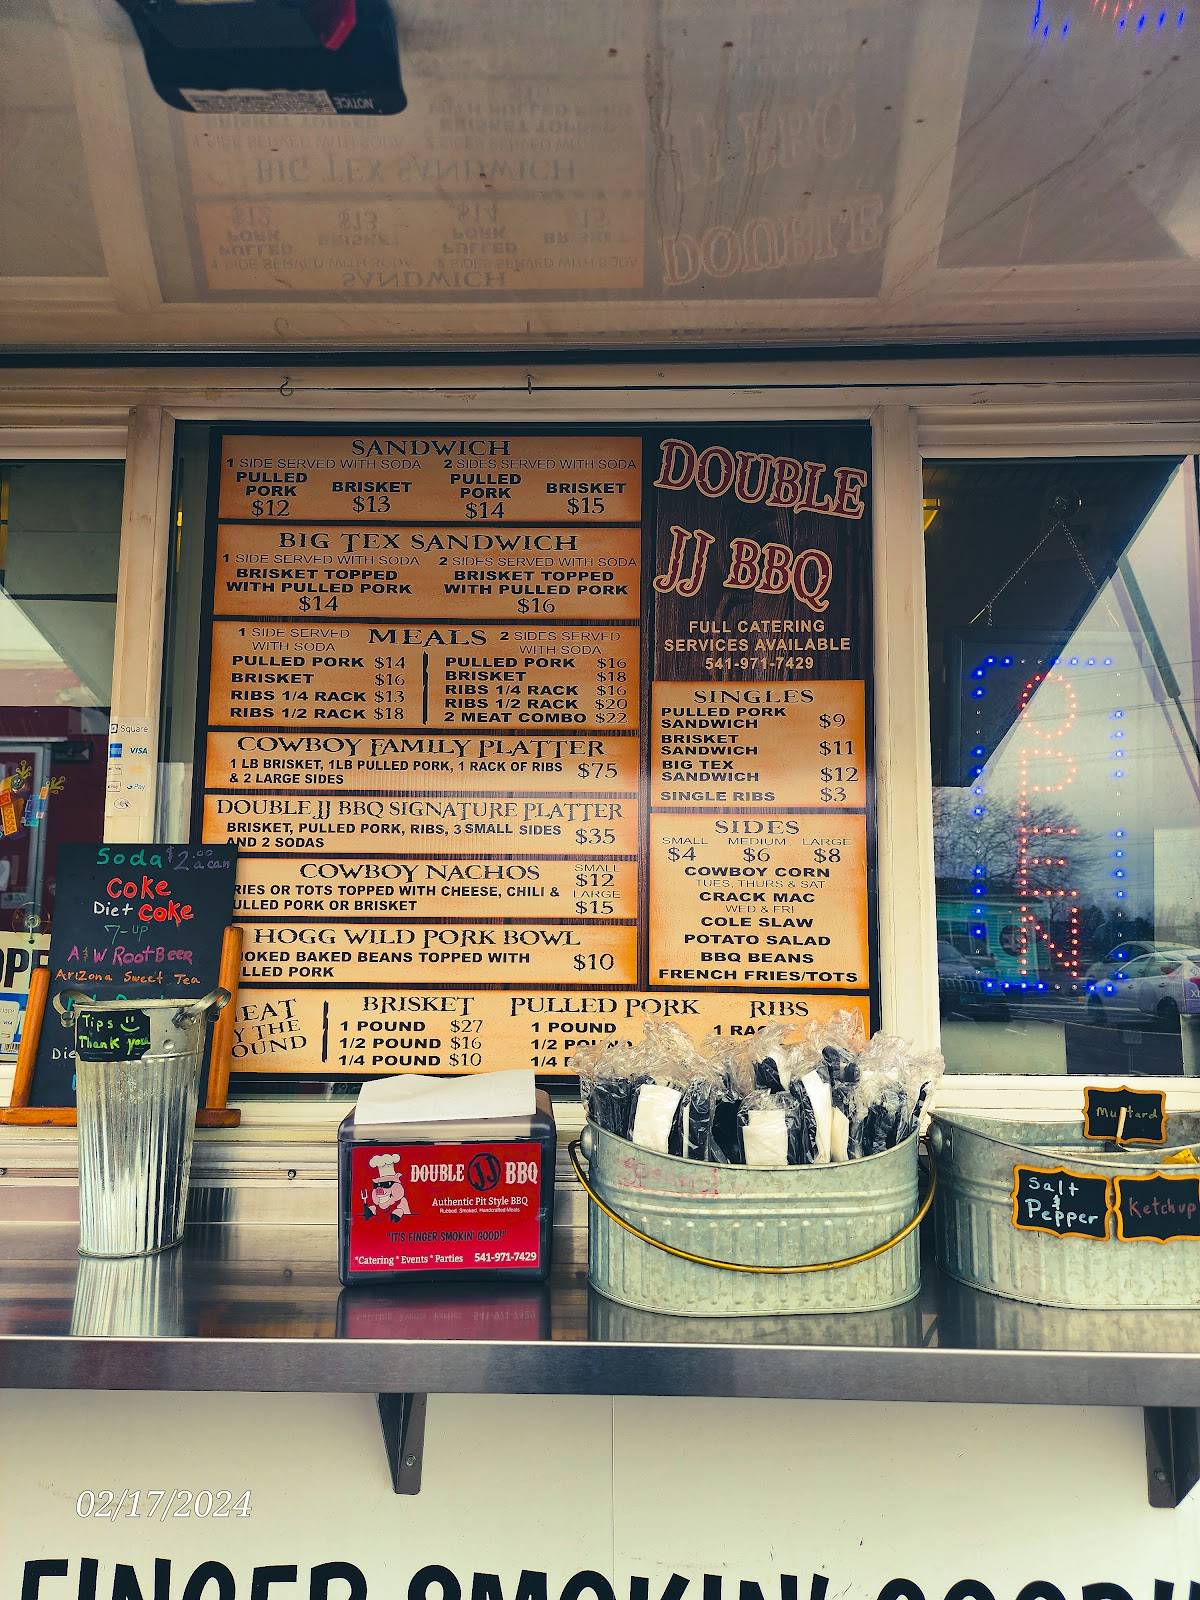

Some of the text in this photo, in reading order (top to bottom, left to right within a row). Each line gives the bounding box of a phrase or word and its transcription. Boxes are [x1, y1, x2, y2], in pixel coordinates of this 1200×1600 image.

[334, 96, 374, 110] NOTICE
[352, 439, 510, 458] SANDWICH
[226, 458, 422, 469] 1 SIDE SERVED WITH SODA
[236, 472, 307, 483] PULLED
[450, 473, 521, 485] PULLED
[653, 438, 867, 520] DOUBLE
[245, 486, 296, 497] PORK
[332, 482, 412, 493] BRISKET
[460, 488, 511, 499] PORK
[546, 483, 626, 494] BRISKET
[252, 499, 289, 518] $12
[353, 497, 391, 514] $13
[465, 501, 505, 519] $14
[567, 498, 605, 514] $15
[279, 532, 577, 553] BIG TEX SANDWICH
[236, 569, 398, 580] BRISKET TOPPED
[653, 525, 833, 613] JJ BBQ
[226, 582, 412, 594] WITH PULLED PORK
[298, 595, 338, 613] $14
[689, 619, 825, 633] FULL CATERING
[368, 628, 488, 648] MEALS
[664, 638, 850, 652] SERVICES AVAILABLE
[232, 655, 405, 671] PULLED PORK $14
[705, 656, 814, 670] 541-971-7429
[231, 672, 405, 686] BRISKET $16
[694, 689, 814, 704] SINGLES
[230, 706, 404, 721] RIBS 1/2 RACK $18
[444, 711, 627, 726] 2 MEAT COMBO $22
[120, 725, 148, 734] Square
[237, 736, 606, 758] COWBOY FAMILY PLATTER
[819, 740, 855, 756] $11
[577, 762, 618, 781] $75
[820, 767, 859, 783] $12
[230, 774, 344, 785] & 2 LARGE SIDES
[661, 791, 775, 802] SINGLE RIBS
[217, 799, 623, 822] DOUBLE JJ BBQ SIGNATURE PLATTER
[715, 820, 800, 835] SIDES
[1019, 671, 1080, 977] OPEN
[261, 837, 270, 848] 2
[274, 837, 324, 848] SODAS
[575, 827, 616, 846] $35
[96, 848, 163, 868] Soda
[667, 847, 696, 862] $4
[743, 848, 770, 863] $6
[814, 848, 841, 864] $8
[299, 863, 540, 883] COWBOY NACHOS
[574, 863, 620, 872] SMALL
[574, 873, 615, 888] $12
[573, 890, 620, 899] LARGE
[700, 892, 815, 903] CRACK MAC
[93, 901, 133, 917] Diet
[575, 900, 614, 915] $15
[725, 905, 756, 913] WED
[760, 905, 768, 913] &
[701, 917, 813, 928] COLE SLAW
[253, 928, 580, 948] HOGG WILD PORK BOWL
[573, 953, 614, 971] $10
[124, 971, 163, 984] Sweet
[174, 974, 201, 985] Tea
[659, 969, 858, 983] FRENCH FRIES/TOTS
[362, 996, 475, 1016] BRISKET
[510, 998, 699, 1018] PULLED PORK
[750, 1000, 809, 1018] RIBS
[82, 1014, 113, 1032] Tips
[79, 1035, 120, 1050] Thank
[52, 1047, 77, 1059] Die
[1096, 1106, 1158, 1119] Mutard
[410, 1164, 465, 1183] DOUBLE
[505, 1162, 538, 1184] BBQ
[1028, 1177, 1079, 1195] Salt
[432, 1196, 528, 1207] Authentic Pit Style BBQ
[1129, 1197, 1197, 1219] Ketchup
[1025, 1199, 1099, 1227] Pepper
[409, 1232, 439, 1242] FINGER
[401, 1255, 428, 1264] Events
[435, 1254, 463, 1263] Parties
[474, 1252, 537, 1262] 541-971-7429
